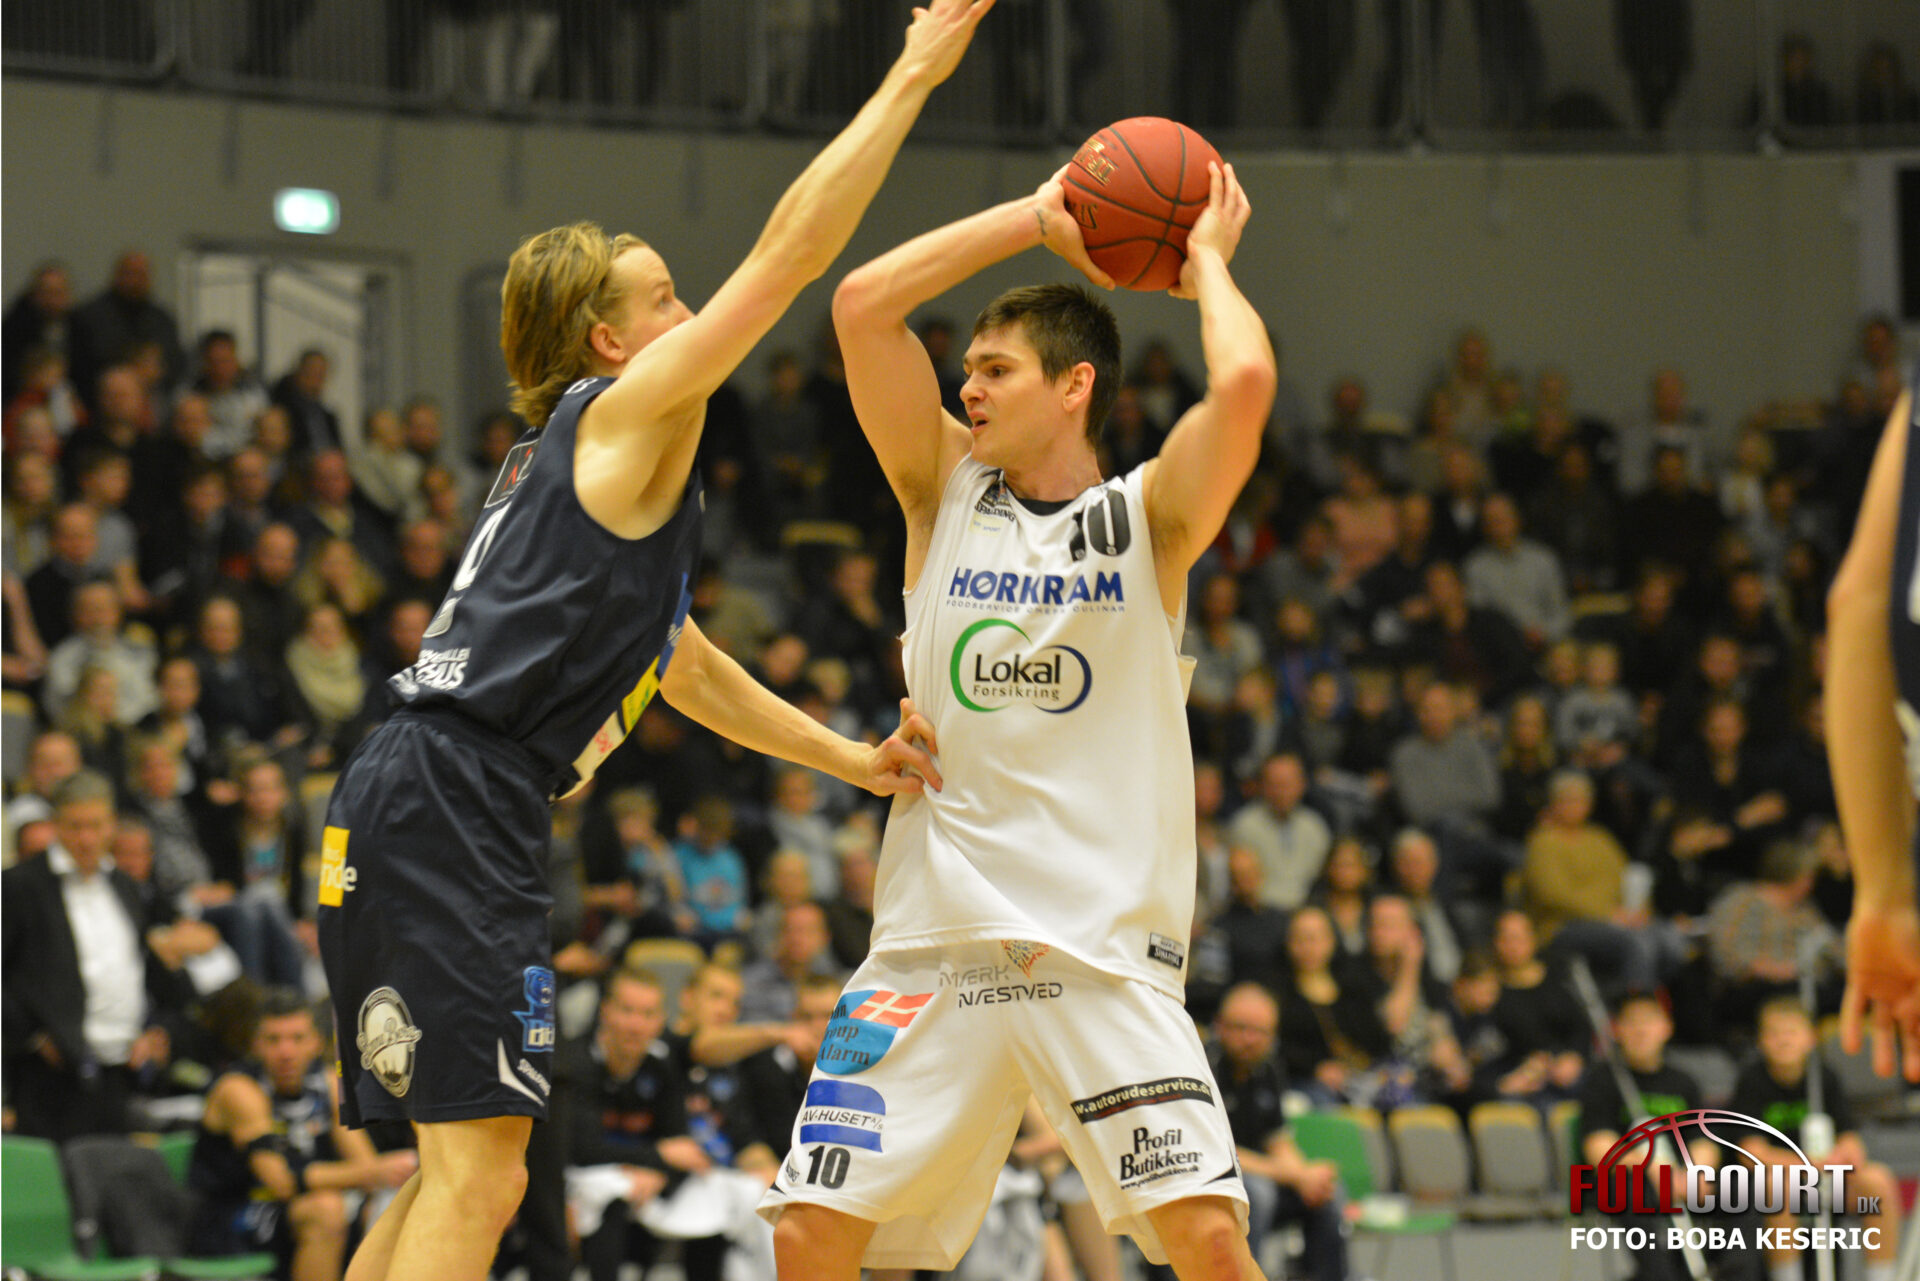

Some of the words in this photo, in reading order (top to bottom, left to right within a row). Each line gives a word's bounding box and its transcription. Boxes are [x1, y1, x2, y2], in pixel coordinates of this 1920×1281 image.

[949, 567, 1124, 605] HØRKRAM
[975, 654, 1060, 684] Lokal
[973, 685, 1060, 700] Forsikring
[1133, 1127, 1182, 1154] Profil
[806, 1145, 851, 1189] 10
[1120, 1150, 1200, 1181] Butikken
